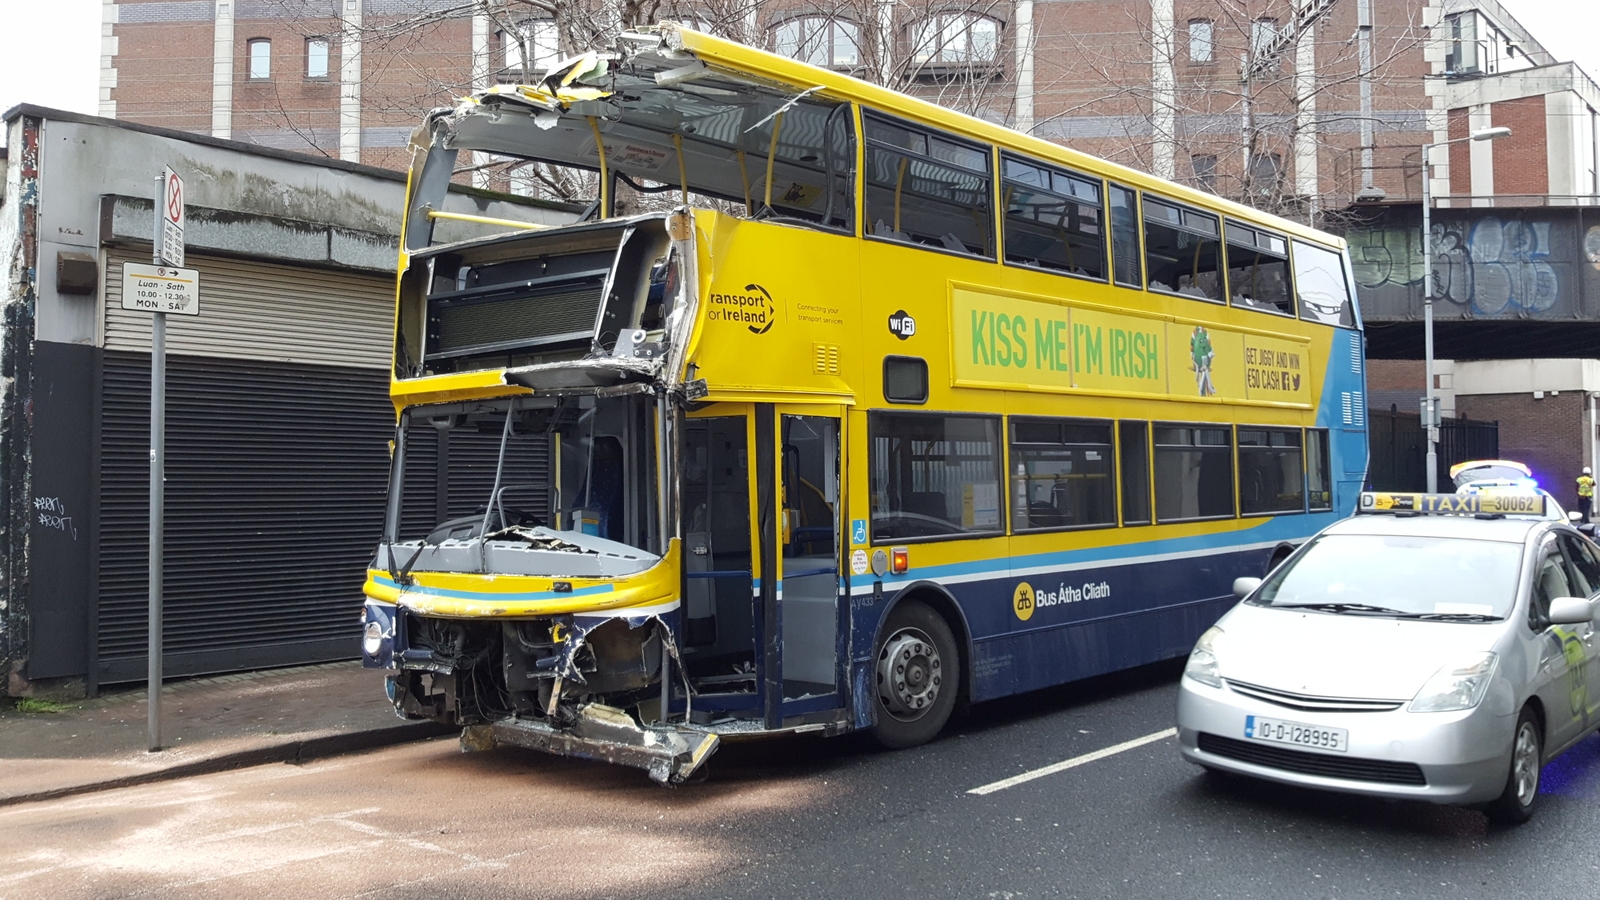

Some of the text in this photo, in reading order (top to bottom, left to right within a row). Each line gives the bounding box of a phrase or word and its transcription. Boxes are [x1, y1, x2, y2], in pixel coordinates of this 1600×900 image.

[138, 280, 158, 289] Luan
[166, 282, 185, 291] Sath
[137, 290, 158, 299] 10.00
[164, 292, 184, 301] 12.30
[710, 292, 765, 308] ransport
[136, 299, 158, 309] MON
[168, 302, 187, 311] SAT
[797, 302, 839, 315] Connecting your
[707, 307, 766, 324] or Ireland
[798, 314, 843, 325] transport services
[971, 309, 1159, 380] KISS ME I'M IRISH
[1245, 347, 1300, 370] GET JIGGY AND WIN
[1247, 368, 1260, 389] €50
[1262, 369, 1280, 391] CASH
[1363, 495, 1374, 507] D
[1426, 496, 1476, 511] TAXI
[1495, 496, 1534, 511] 30062
[1036, 581, 1110, 608] Bus Átha Cliath
[1259, 722, 1339, 748] 10-D-128995
